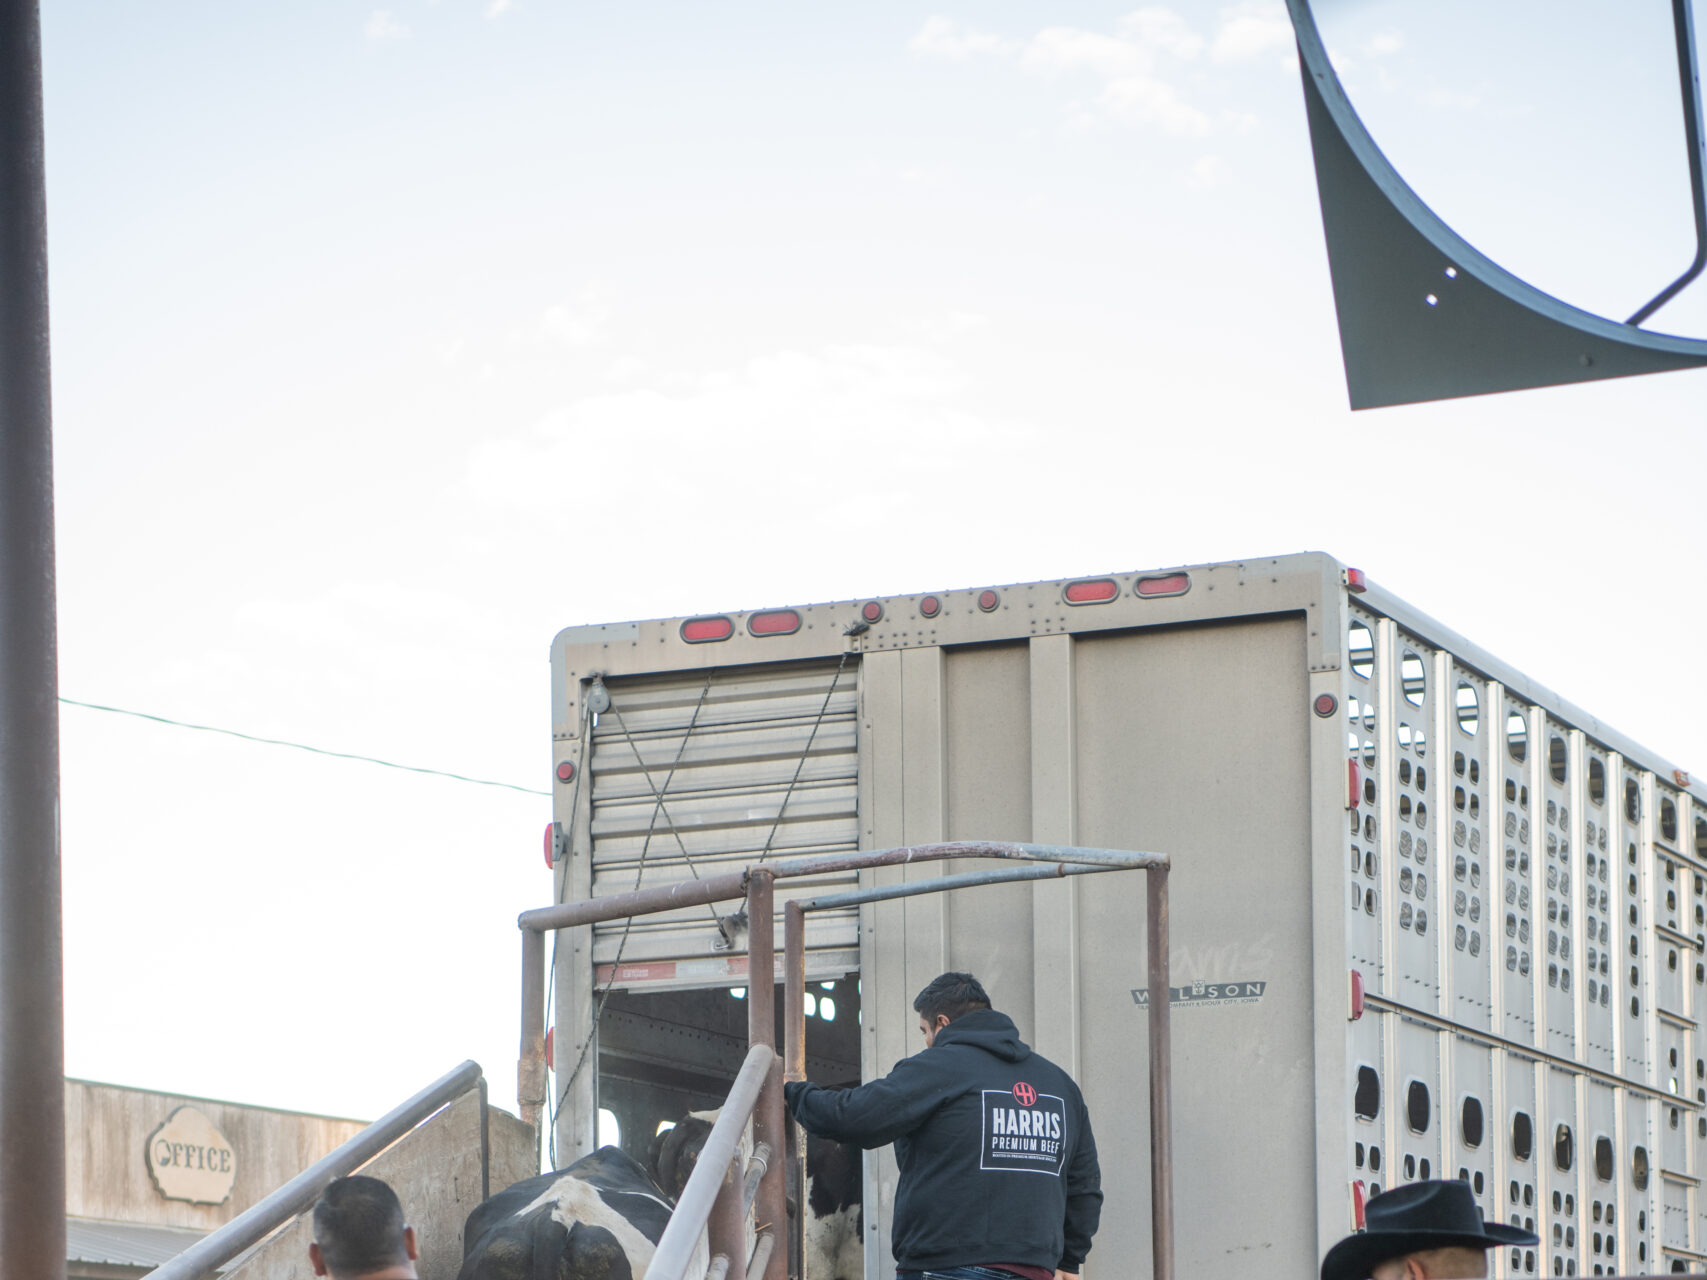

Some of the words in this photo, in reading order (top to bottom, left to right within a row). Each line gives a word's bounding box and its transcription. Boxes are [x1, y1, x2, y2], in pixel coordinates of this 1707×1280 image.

[1135, 983, 1261, 1002] WLSON
[992, 1107, 1060, 1139] HARRIS
[155, 1139, 231, 1173] OFFICE
[991, 1136, 1037, 1151] PREMIUM
[1040, 1139, 1060, 1154] BEEF
